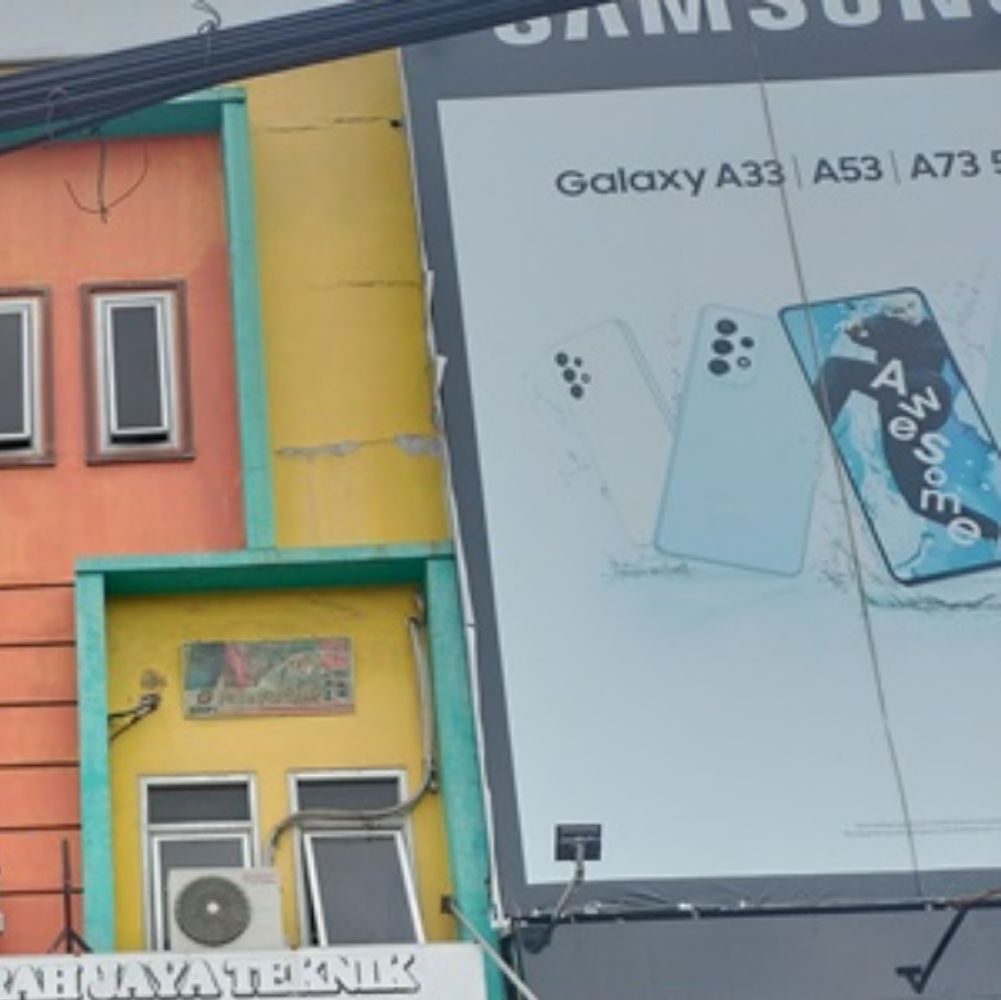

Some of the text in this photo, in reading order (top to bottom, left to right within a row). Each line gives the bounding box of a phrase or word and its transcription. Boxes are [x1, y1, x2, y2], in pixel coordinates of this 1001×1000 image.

[494, 0, 1001, 45] AMSU
[555, 166, 707, 197] Galaxy
[715, 160, 786, 189] A33
[812, 155, 883, 184] A53
[909, 150, 981, 180] A73
[222, 953, 422, 999] TEKNIK
